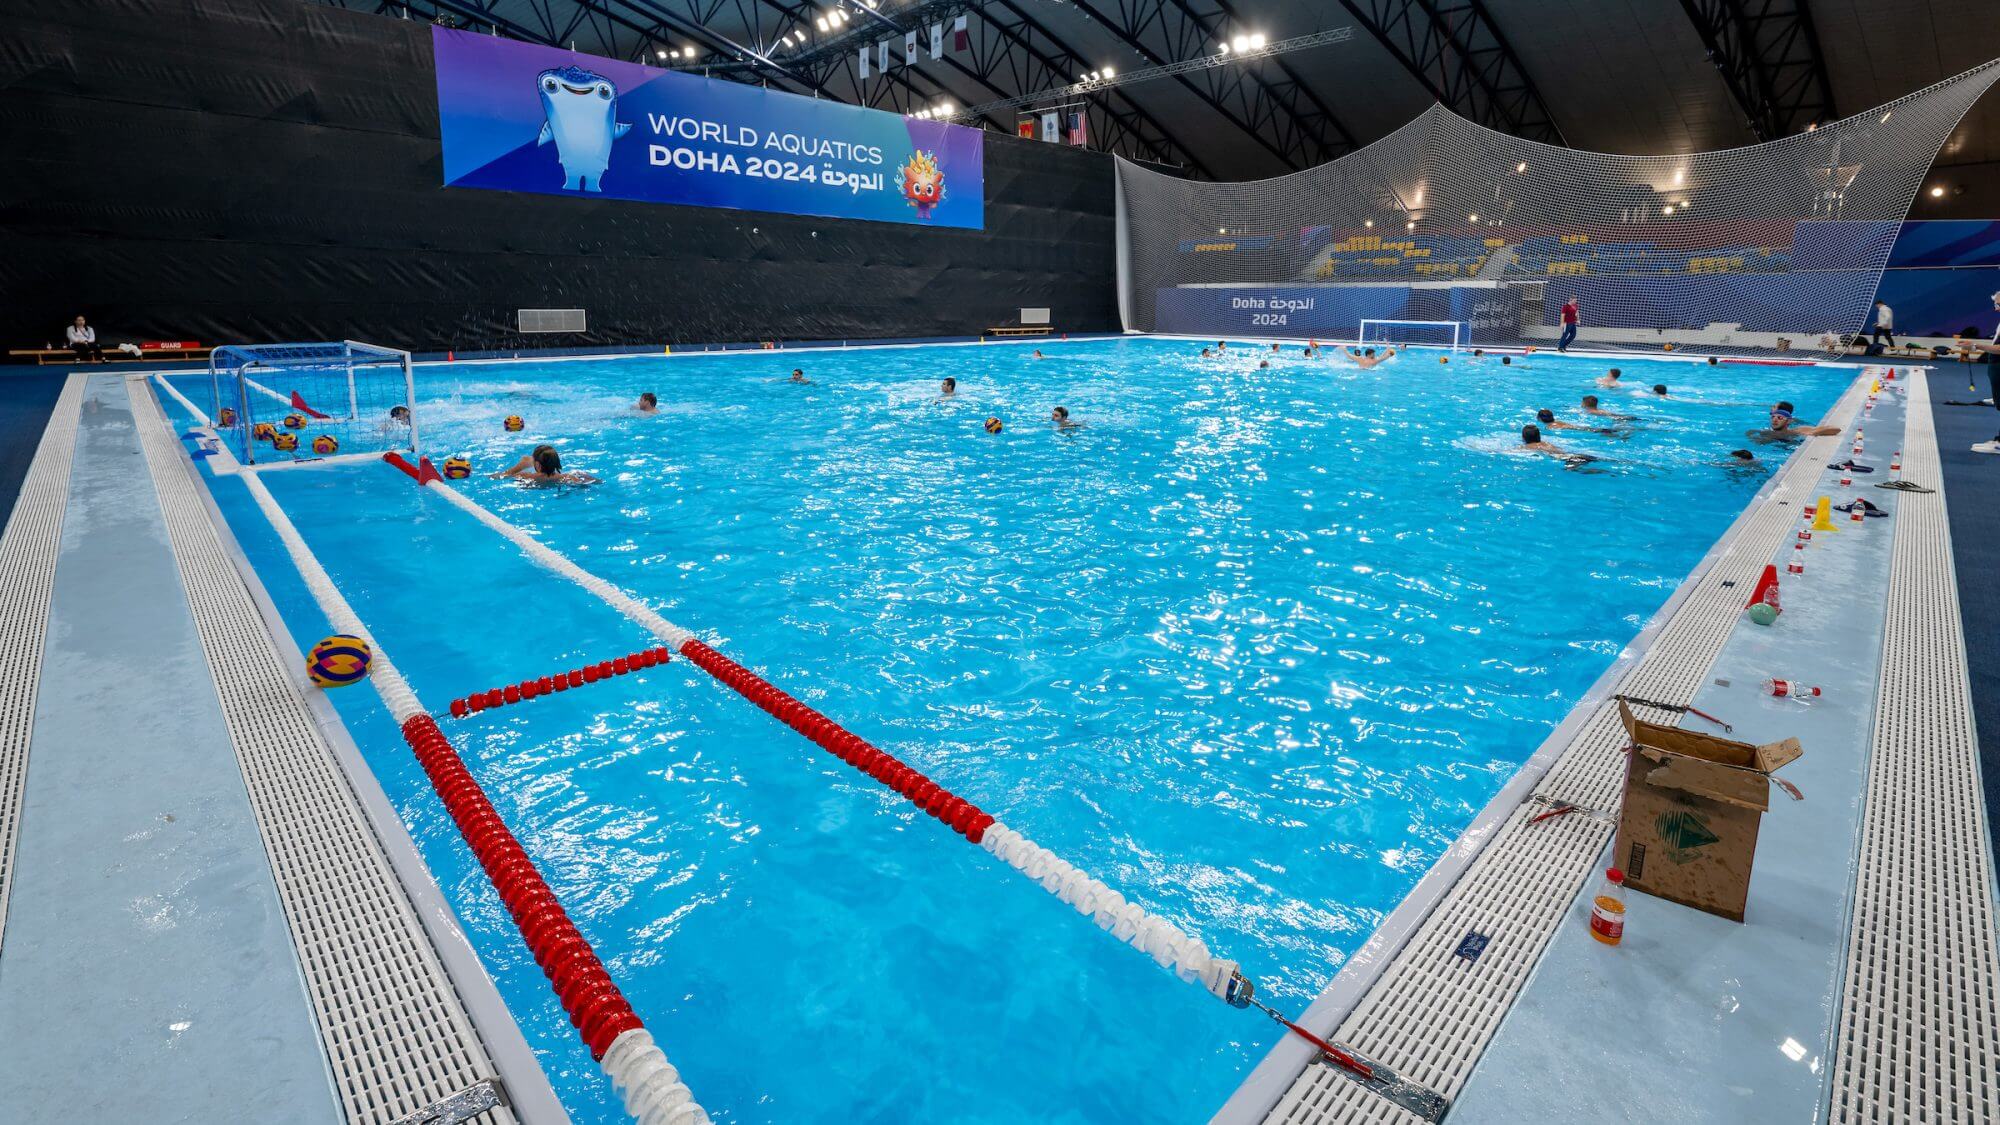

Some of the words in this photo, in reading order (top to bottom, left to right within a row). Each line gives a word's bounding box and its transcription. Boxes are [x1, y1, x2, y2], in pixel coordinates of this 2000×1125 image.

[648, 112, 758, 148] WORLD
[764, 131, 883, 165] AQUATICS
[649, 144, 741, 175] DOHA
[746, 156, 817, 183] 2024
[821, 163, 884, 195] الدوحة
[1232, 297, 1265, 309] Doha
[1269, 296, 1314, 313] الدوحة
[1252, 314, 1287, 326] 2024
